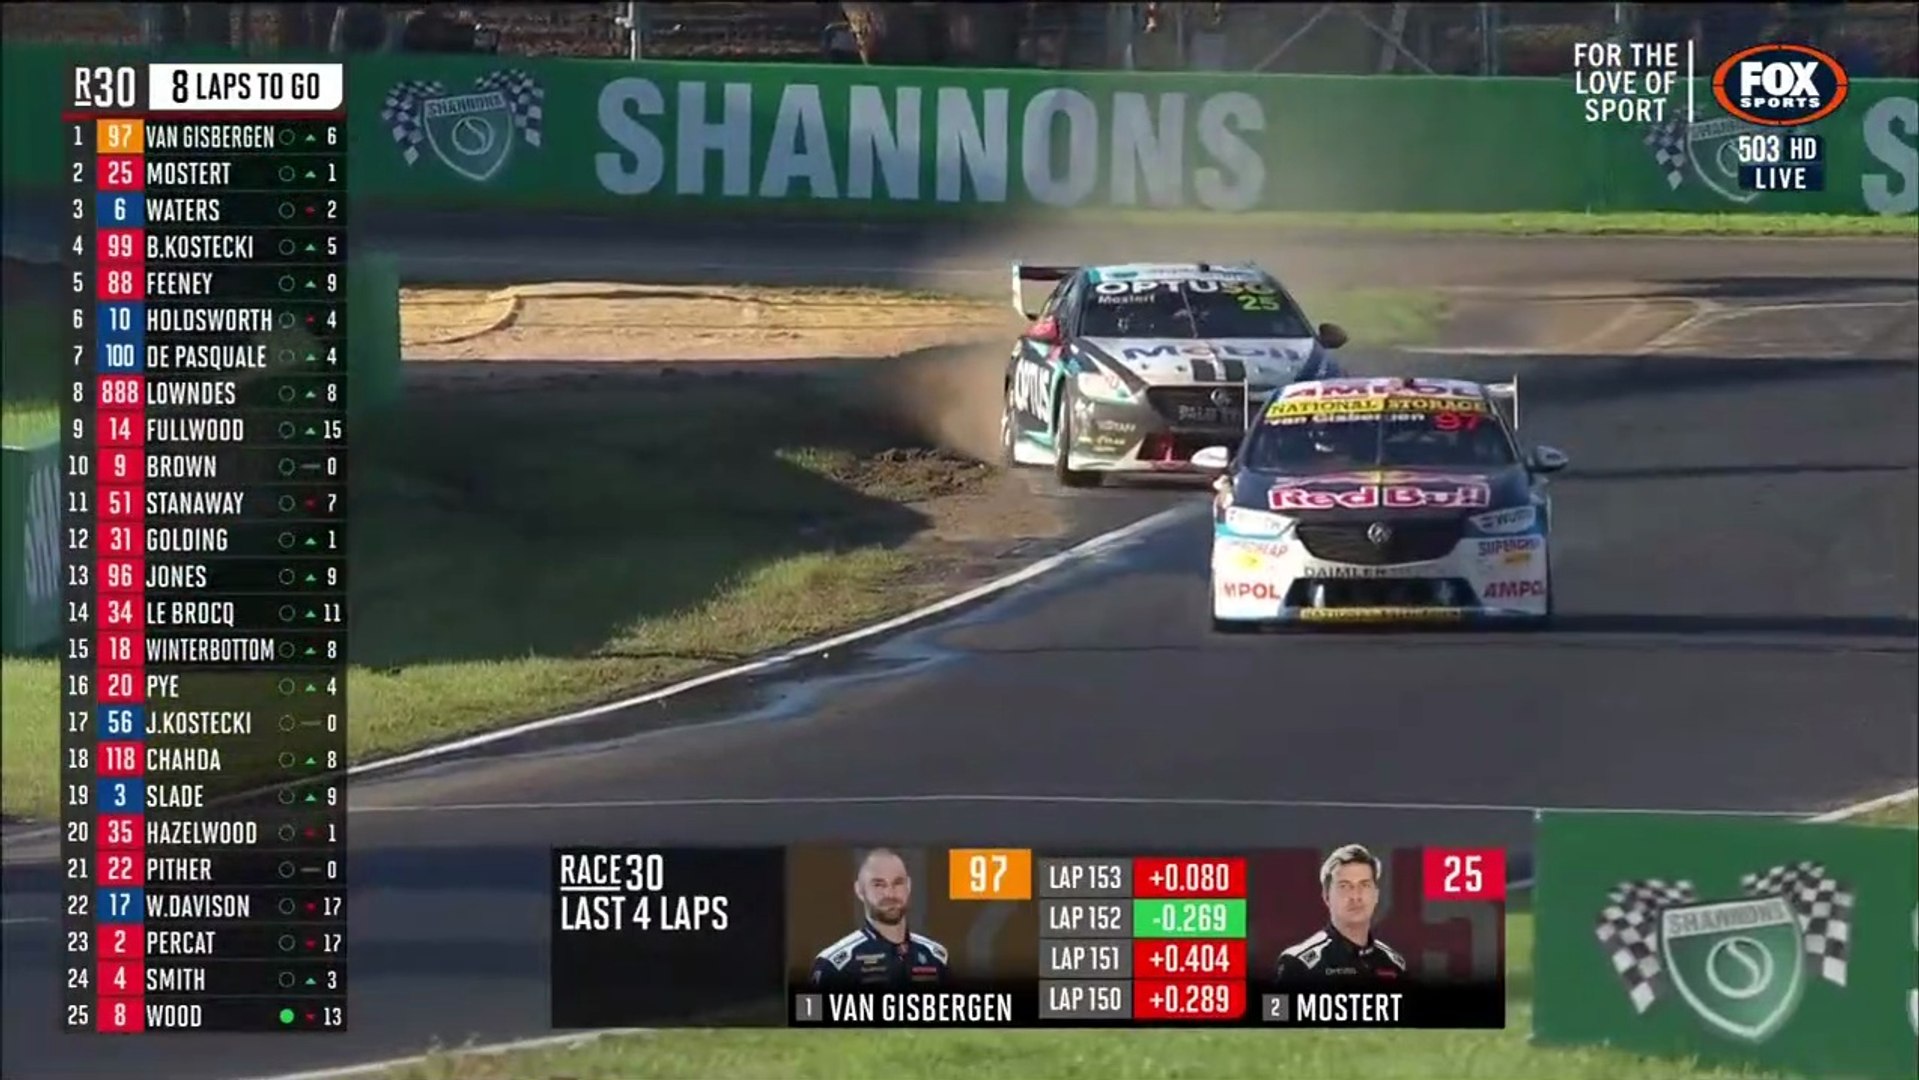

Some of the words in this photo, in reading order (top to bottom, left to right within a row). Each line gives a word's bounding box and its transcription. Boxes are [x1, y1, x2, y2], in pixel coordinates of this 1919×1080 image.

[595, 78, 1266, 212] SHANNONS
[1237, 295, 1280, 311] 25
[1271, 400, 1376, 414] NATIONAL
[1385, 398, 1488, 412] STORAGE
[1434, 412, 1478, 431] 97
[1269, 487, 1376, 508] Red
[1384, 487, 1491, 507] Bull
